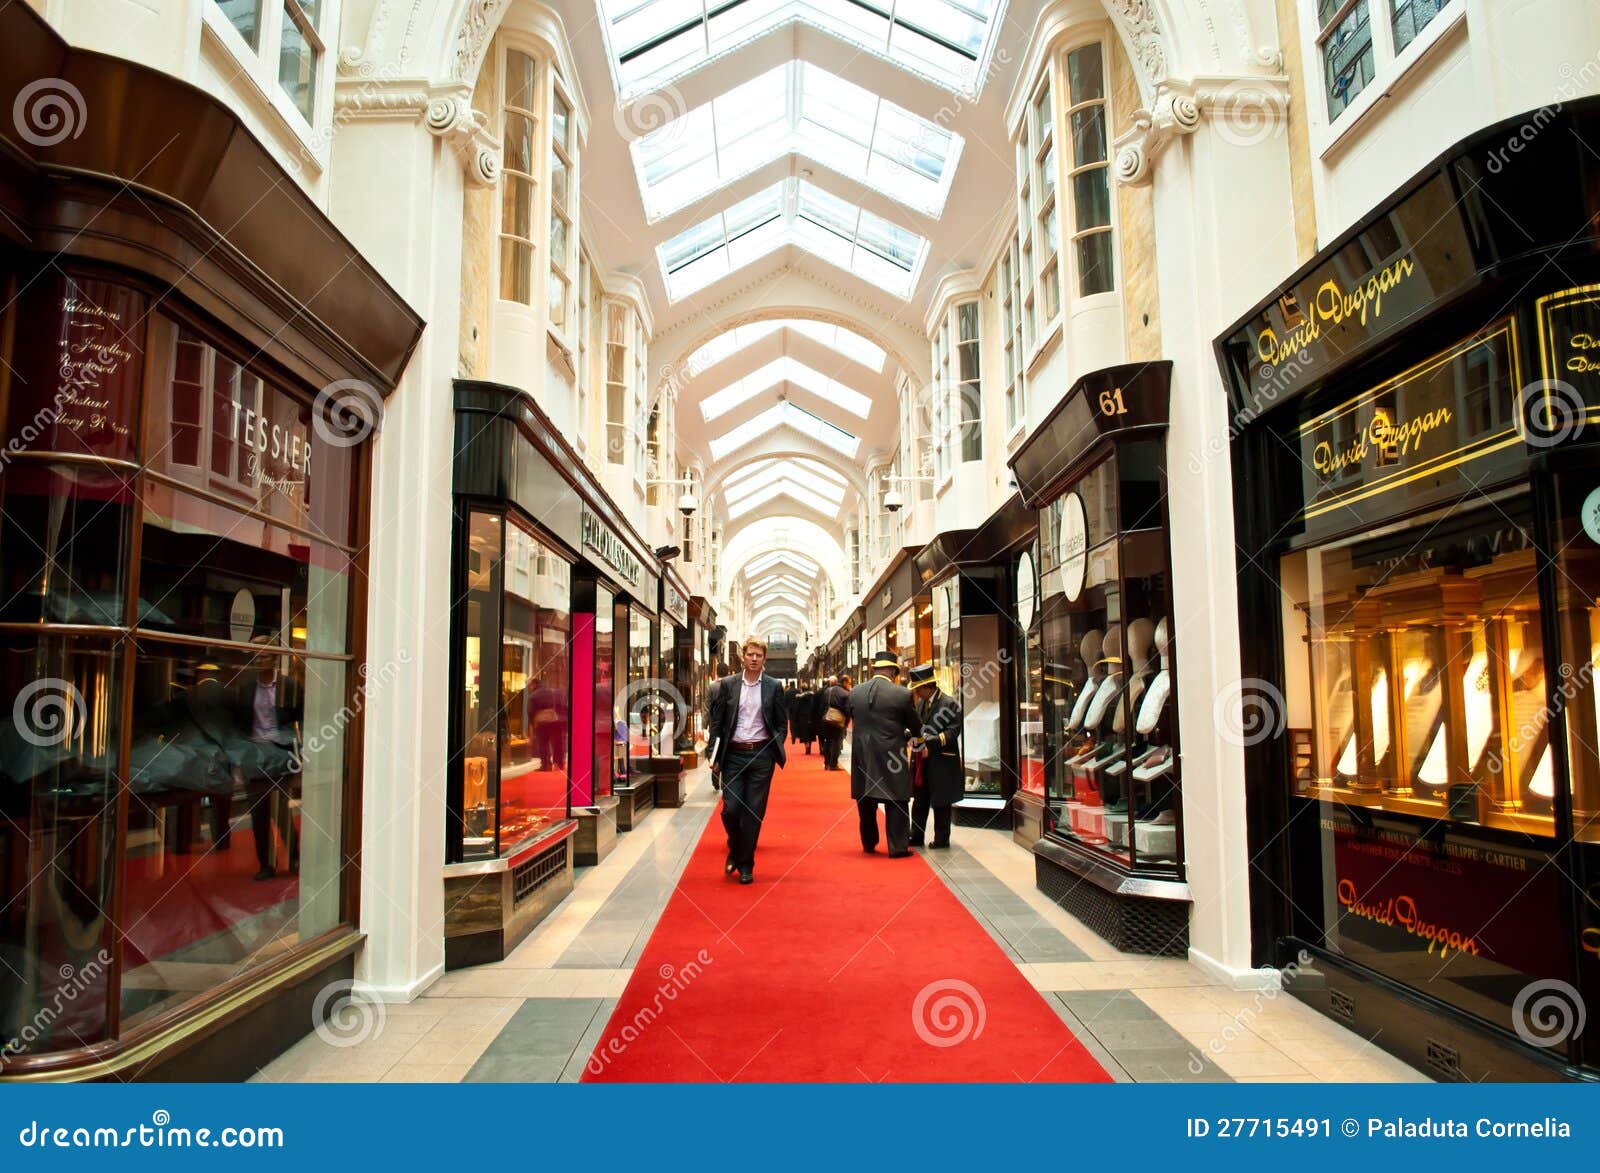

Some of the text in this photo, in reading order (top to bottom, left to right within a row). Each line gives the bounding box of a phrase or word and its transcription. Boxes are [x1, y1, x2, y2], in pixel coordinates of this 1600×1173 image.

[1257, 257, 1414, 366] David Duggan
[71, 336, 133, 362] Jewellery
[1099, 387, 1128, 416] 61
[231, 399, 312, 477] TESSIER
[1313, 406, 1453, 475] David Duggan
[1485, 852, 1527, 872] CARTIER
[1337, 878, 1479, 959] David Duggan
